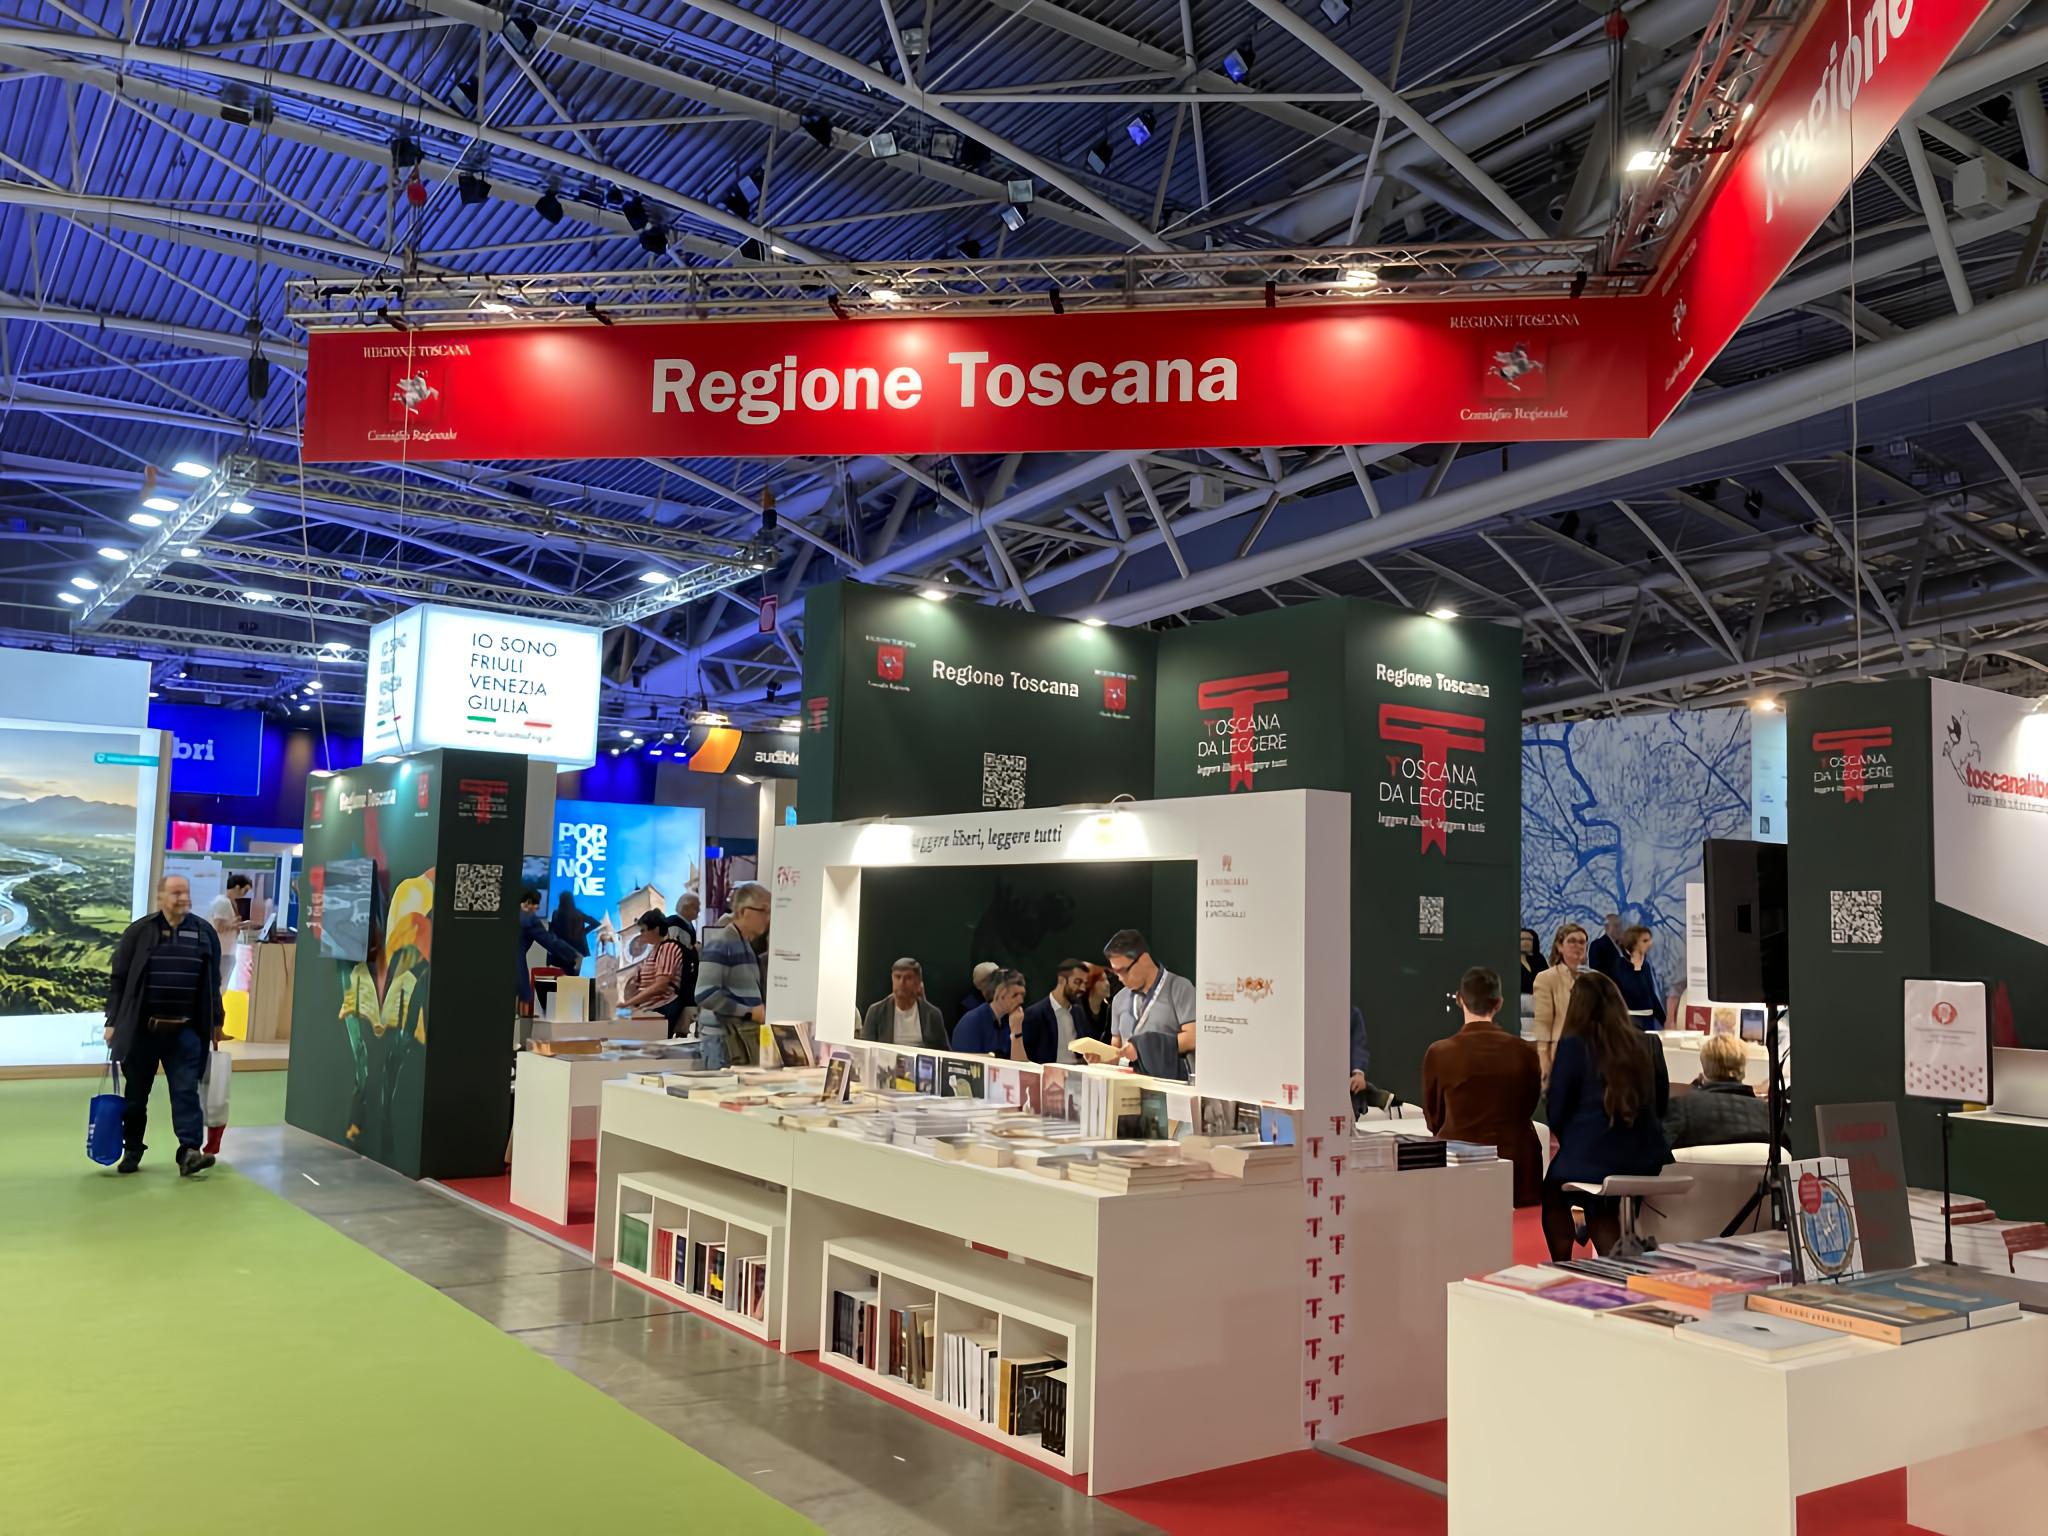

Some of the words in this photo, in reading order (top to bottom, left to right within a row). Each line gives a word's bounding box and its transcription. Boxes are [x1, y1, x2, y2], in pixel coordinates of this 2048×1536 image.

[652, 355, 922, 425] Regione
[948, 351, 1238, 408] Toscana
[472, 633, 493, 649] IO
[500, 637, 558, 658] SONO
[470, 654, 523, 674] FRIULI
[469, 674, 548, 697] VENEZIA
[932, 660, 1004, 686] Regione
[1011, 672, 1079, 697] Toscana
[1376, 663, 1432, 688] Regione
[1436, 673, 1490, 698] Toscana
[467, 695, 530, 715] GIULIA
[1203, 713, 1280, 737] TOSCANA
[1198, 741, 1218, 757] DA
[1222, 733, 1287, 755] LEGGERE
[1387, 755, 1478, 786] TOSCANA
[1379, 782, 1404, 803] DA
[1410, 786, 1485, 812] LEGGERE
[988, 828, 1031, 850] leggere
[1034, 824, 1062, 843] tutti
[573, 877, 606, 896] NE
